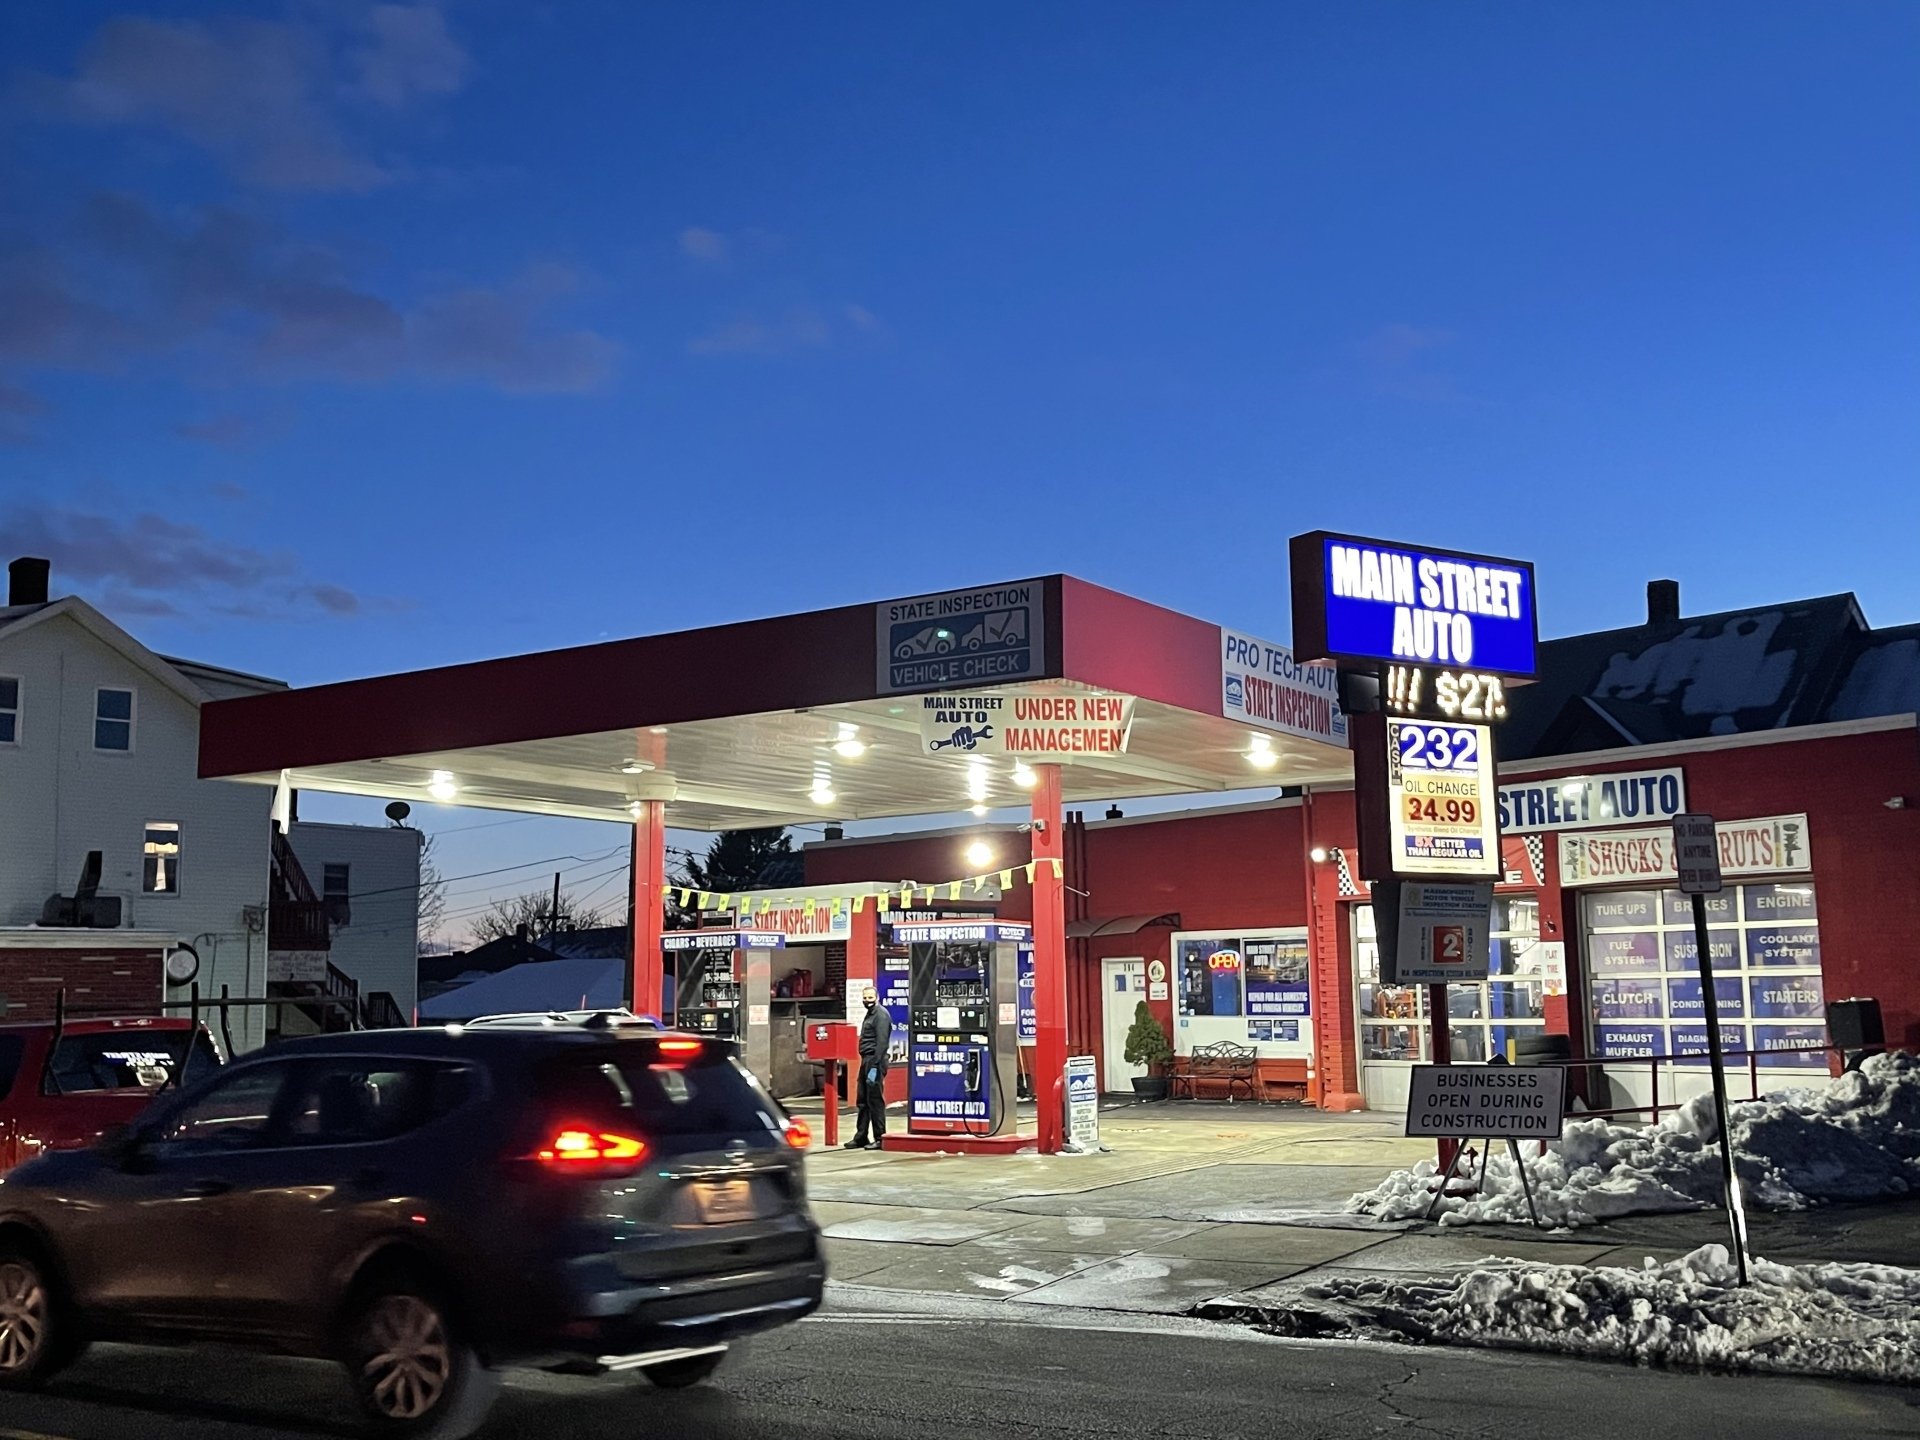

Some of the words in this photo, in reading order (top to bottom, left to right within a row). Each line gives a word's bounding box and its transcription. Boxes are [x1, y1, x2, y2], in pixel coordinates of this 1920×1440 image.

[1331, 545, 1415, 604] MAIN
[1418, 558, 1521, 619] STREET
[890, 601, 934, 621] STATE
[939, 587, 1030, 613] INSPECTION
[1392, 606, 1472, 663] AUTO
[894, 661, 958, 684] VEHICLE
[964, 653, 1020, 676] CHECK
[1226, 635, 1260, 668] PRO
[1265, 647, 1303, 682] TECH
[1306, 665, 1338, 693] AUT
[924, 697, 956, 709] MAIN
[960, 697, 1003, 709] STREET
[1015, 698, 1077, 720] UNDER
[1083, 698, 1123, 721] NEW
[1245, 674, 1274, 721] STATE
[1275, 684, 1331, 736] INSPECTION
[935, 711, 988, 723] AUTO
[1005, 728, 1126, 751] MANAGEMEN
[1400, 725, 1478, 769] 232
[1390, 725, 1402, 776] CASH
[1405, 780, 1424, 793] OIL
[1428, 781, 1477, 796] CHANGE
[1601, 774, 1680, 818] AUTO
[1435, 839, 1466, 848] BETTER
[1407, 847, 1430, 857] THAN
[1431, 848, 1468, 858] REGULAR
[1468, 849, 1482, 858] OIL
[1589, 837, 1663, 876] SHOCKS
[1718, 828, 1773, 867] RUTS
[1596, 905, 1624, 915] TUNE
[1626, 904, 1647, 914] UPS
[1674, 899, 1728, 912] BRKES
[1757, 896, 1811, 908] ENGINE
[754, 911, 778, 929] STATE
[780, 907, 830, 934] INSPECTION
[900, 928, 929, 941] STATE
[929, 926, 986, 940] INSPECTION
[1759, 935, 1815, 944] COOLANT
[664, 937, 690, 949] CIGARS
[696, 935, 736, 948] BEVERAGES
[1443, 933, 1460, 957] 2
[1609, 941, 1635, 950] FUEL
[1674, 943, 1732, 959] SUSPSION
[1765, 948, 1813, 957] SYSTEM
[1209, 953, 1239, 969] OPEN
[1604, 956, 1645, 965] SYSTEM
[1602, 993, 1653, 1004] CLUTCH
[1763, 991, 1818, 1003] STARTERS
[1673, 1001, 1741, 1009] CONDITNING
[1606, 1034, 1653, 1043] EXHAUST
[1678, 1035, 1741, 1043] DIAGNTICS
[916, 1052, 932, 1061] FULL
[934, 1052, 964, 1061] SERVICE
[1606, 1048, 1653, 1056] MUFFLER
[1437, 1074, 1538, 1088] BUSINESSES
[915, 1100, 935, 1114] MAIN
[936, 1100, 963, 1115] STREET
[964, 1101, 985, 1115] AUTO
[1427, 1094, 1470, 1108] OPEN
[1481, 1094, 1544, 1109] DURING
[1421, 1114, 1547, 1129] CONSTRUCTION
